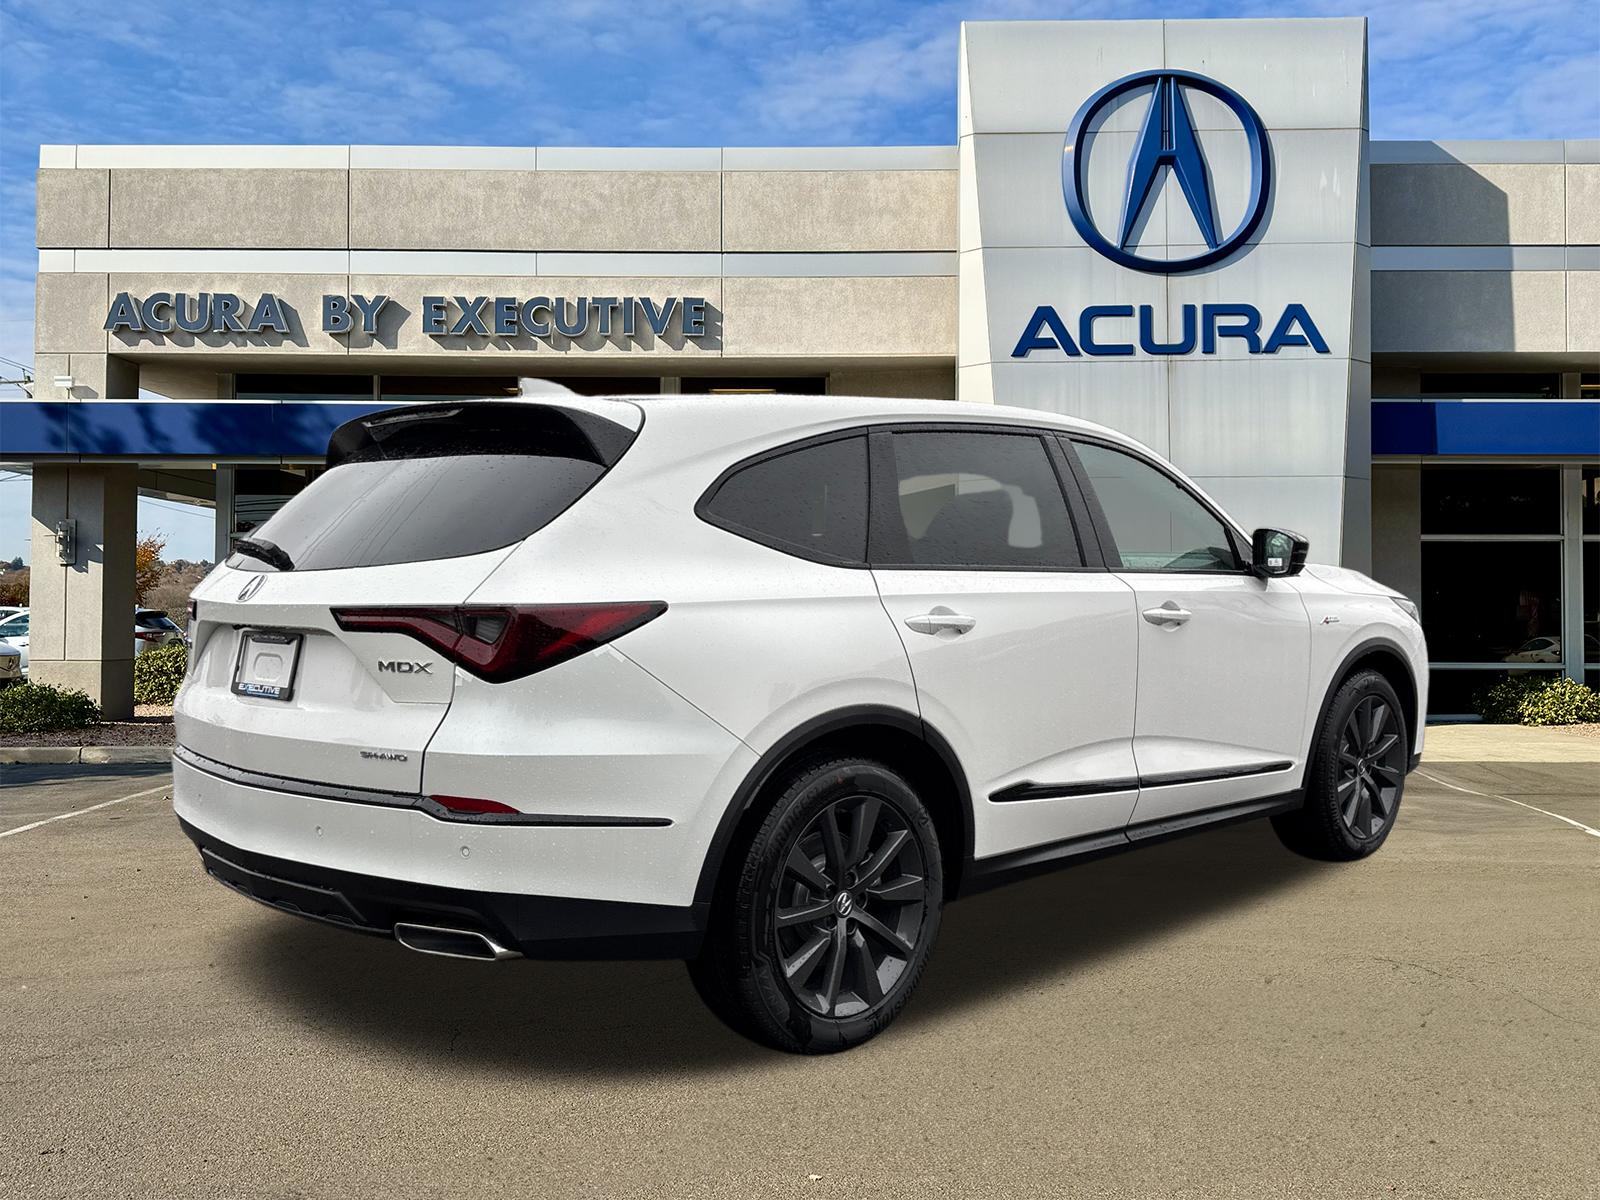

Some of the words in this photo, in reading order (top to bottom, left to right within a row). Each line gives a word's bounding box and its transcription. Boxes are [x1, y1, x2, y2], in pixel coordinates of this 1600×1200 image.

[103, 292, 290, 333] ACURA
[322, 295, 389, 334] BY
[422, 296, 706, 337] EXECUTIVE
[1010, 303, 1331, 357] ACURA
[377, 660, 433, 675] MDX
[238, 683, 281, 695] EXECUTIVE
